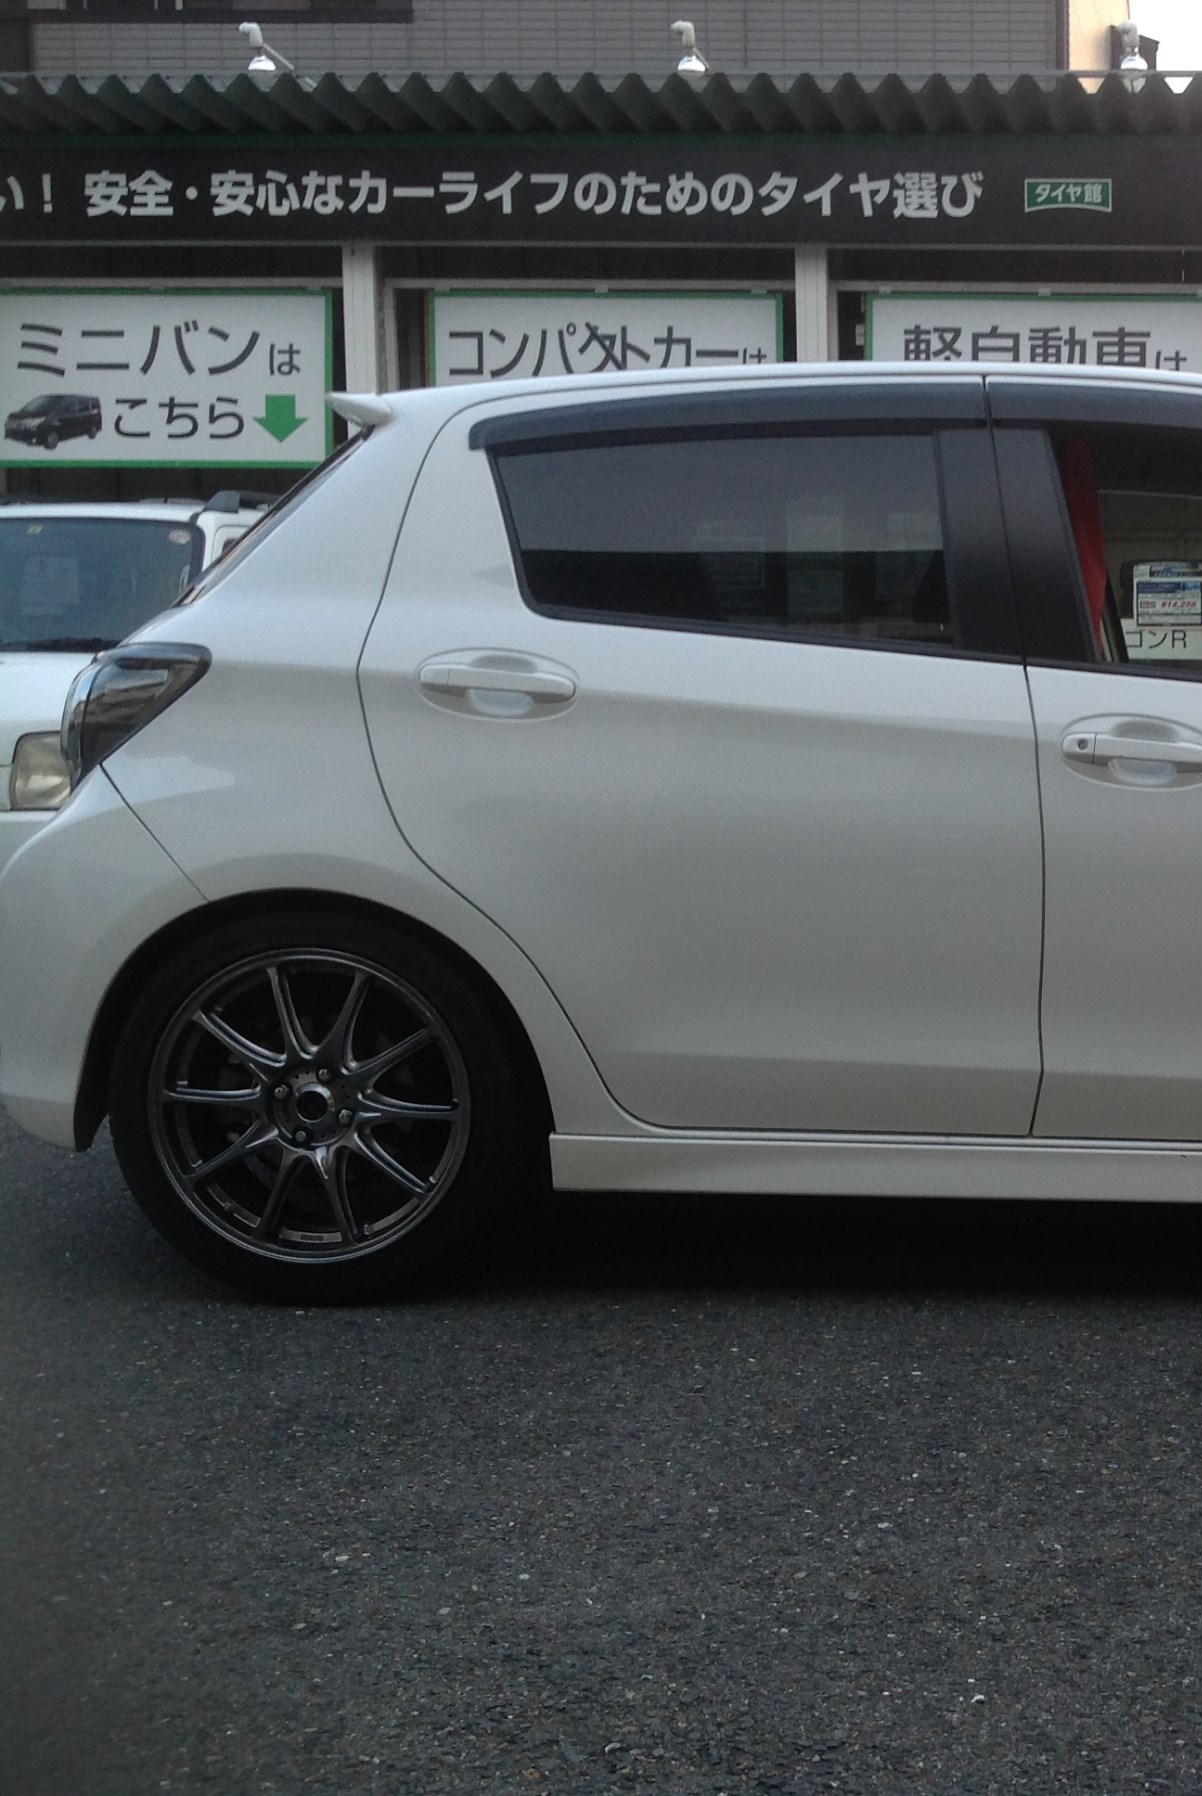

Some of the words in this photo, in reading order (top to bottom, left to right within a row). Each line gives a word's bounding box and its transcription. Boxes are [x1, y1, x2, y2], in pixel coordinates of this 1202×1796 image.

[1035, 183, 1102, 203] タイヤ館
[17, 319, 301, 377] ミニバンは
[114, 396, 245, 440] こちら
